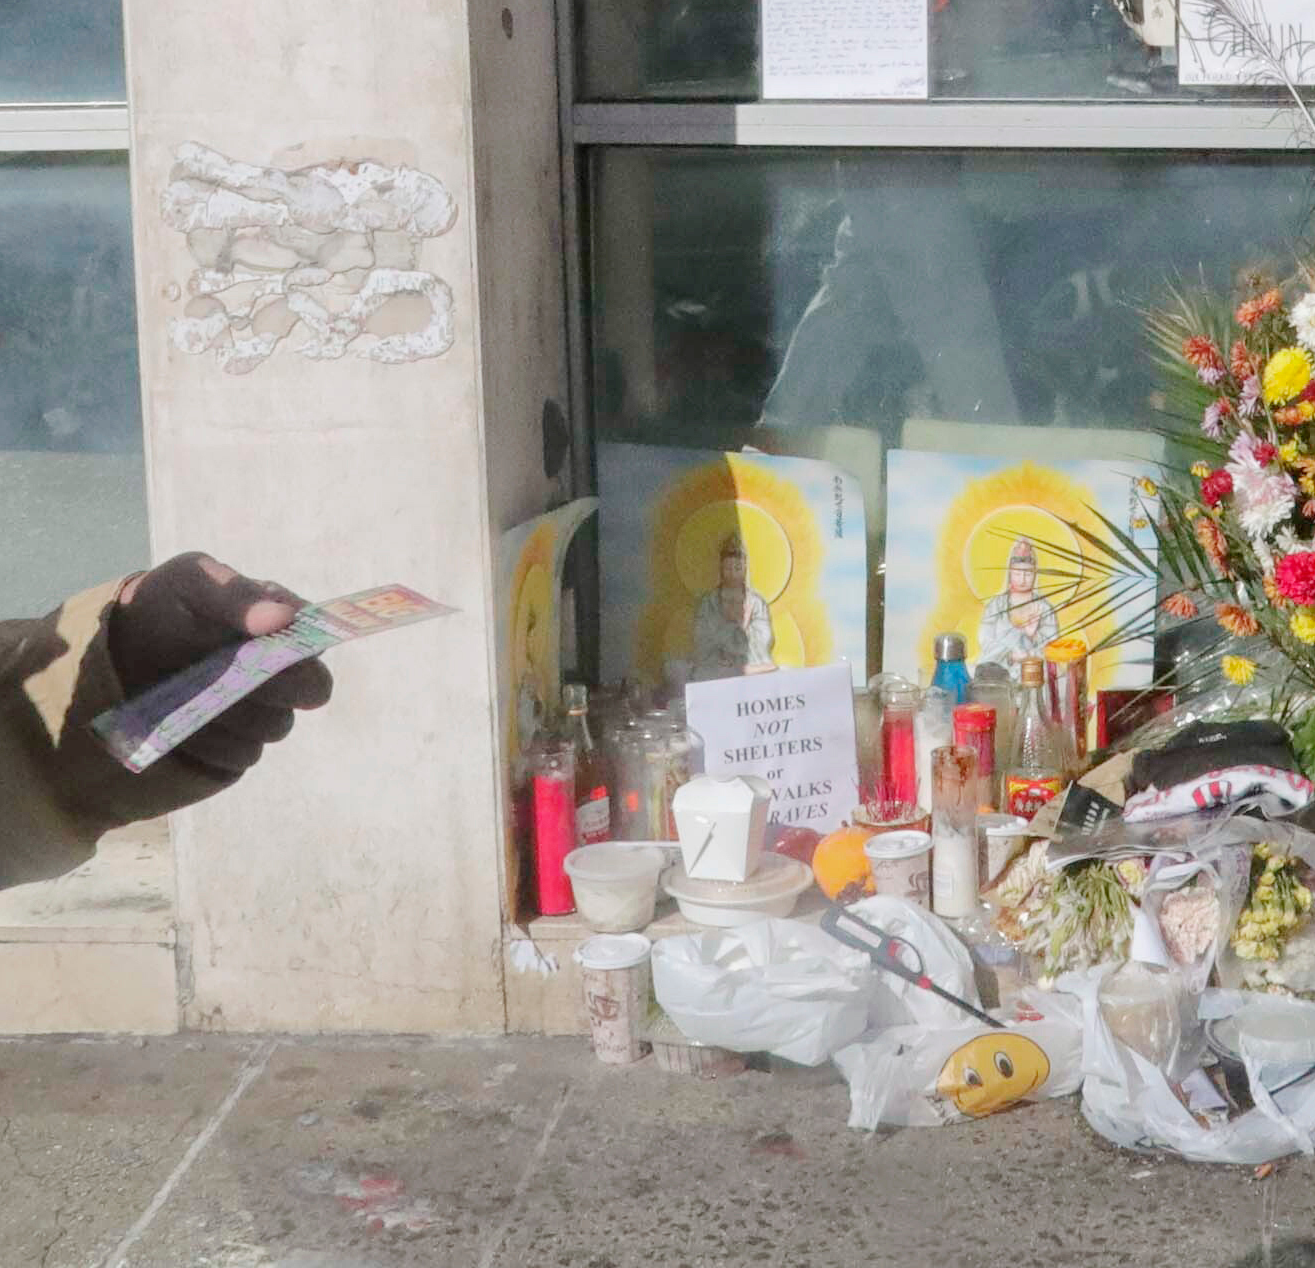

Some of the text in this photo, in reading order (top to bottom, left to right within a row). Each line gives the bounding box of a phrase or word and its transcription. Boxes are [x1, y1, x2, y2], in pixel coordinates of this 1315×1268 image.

[736, 694, 807, 717] HOMES
[753, 718, 794, 738] NOT
[724, 736, 824, 765] SHELTERS
[766, 767, 784, 781] or
[769, 802, 829, 826] RAVES
